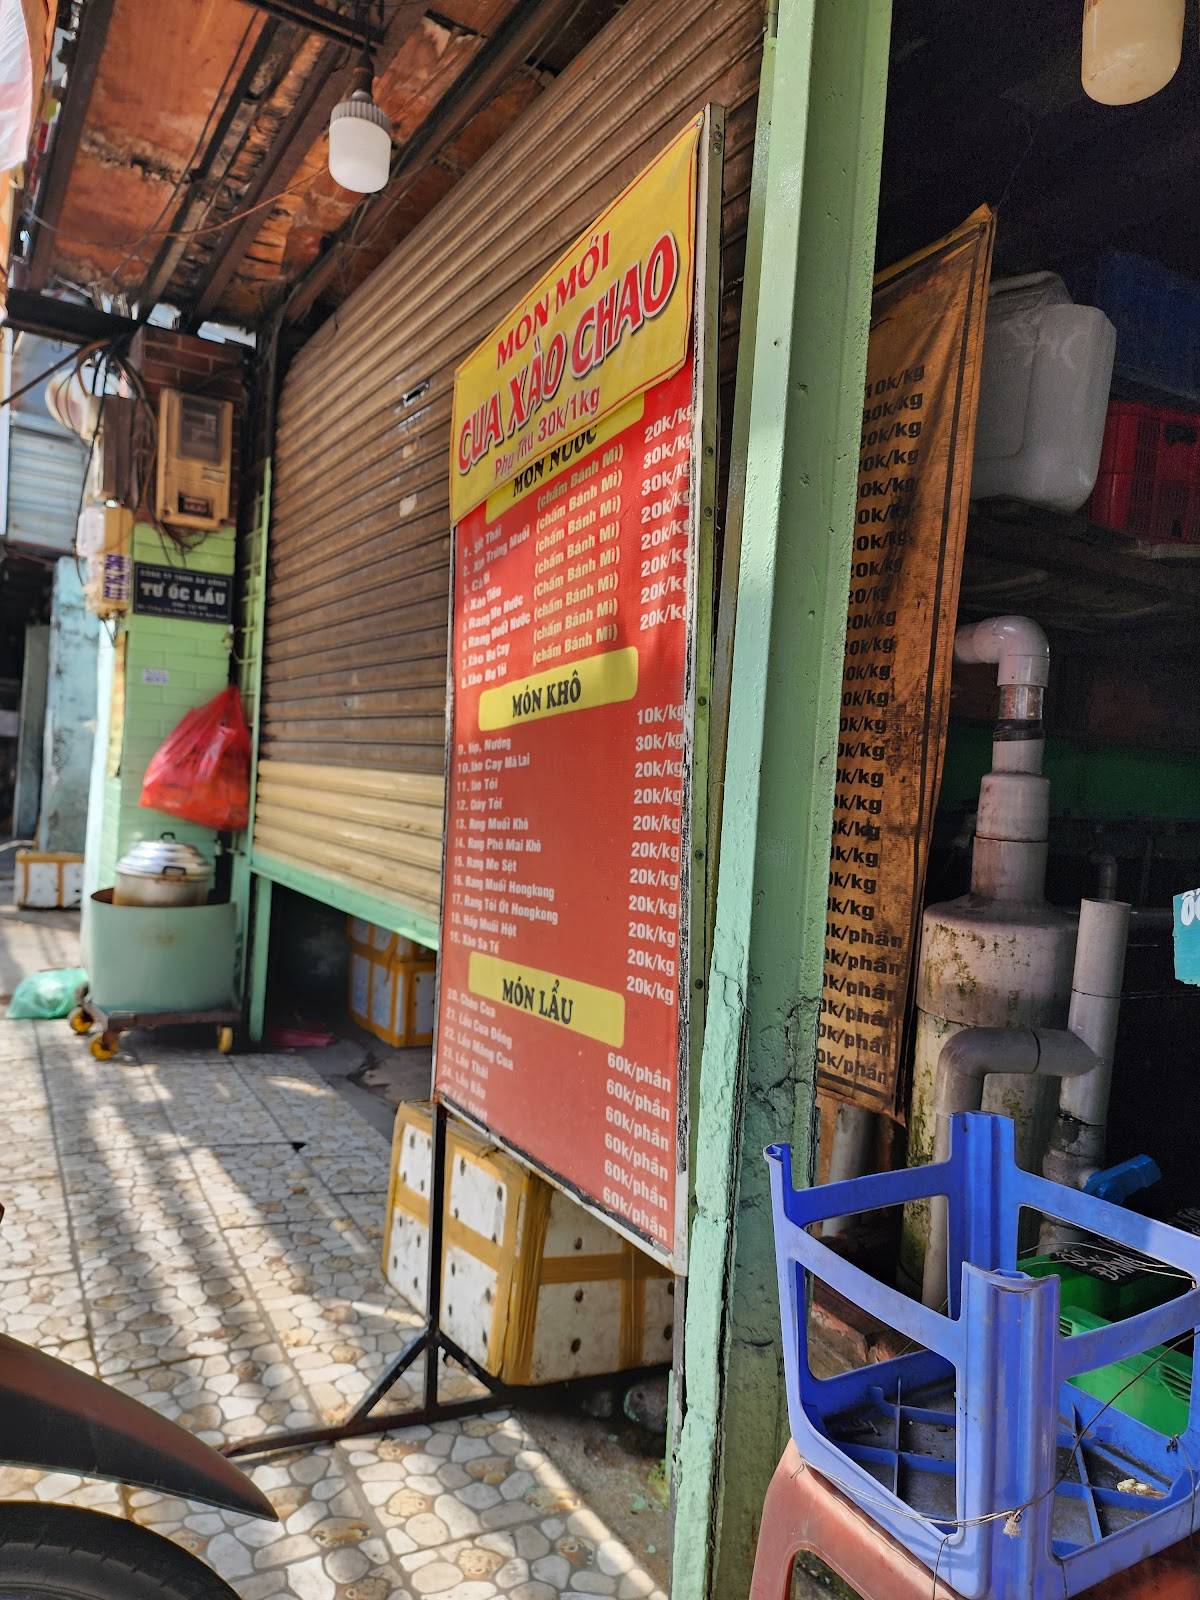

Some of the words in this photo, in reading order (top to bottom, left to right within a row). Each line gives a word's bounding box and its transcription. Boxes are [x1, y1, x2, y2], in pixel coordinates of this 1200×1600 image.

[497, 293, 550, 370] MÓN
[556, 230, 610, 314] MỚI
[458, 391, 504, 475] CUA
[507, 331, 567, 438] XÀO
[571, 230, 681, 379] CHAO
[569, 484, 597, 512] Bánh
[568, 509, 596, 535] Bánh
[567, 534, 595, 560] Bánh
[567, 558, 596, 582] Bánh
[566, 583, 594, 607] Bánh
[565, 607, 593, 630] Bánh
[564, 631, 592, 653] Bánh
[512, 684, 542, 718] MÓN
[546, 669, 581, 709] KHÔ
[634, 759, 684, 778] 20k/kg
[633, 787, 681, 806] 20k/kg
[632, 814, 680, 834] 20k/kg
[631, 841, 679, 862] 20k/kg
[629, 868, 679, 891] 20k/kg
[509, 880, 555, 902] Hongkong
[628, 894, 677, 920] 20k/kg
[511, 902, 558, 925] Hongkong
[628, 921, 676, 948] 20k/kg
[627, 948, 675, 977] 20k/kg
[502, 976, 535, 1011] MÓN
[539, 979, 573, 1025] LẨU
[626, 975, 674, 1006] 20k/kg
